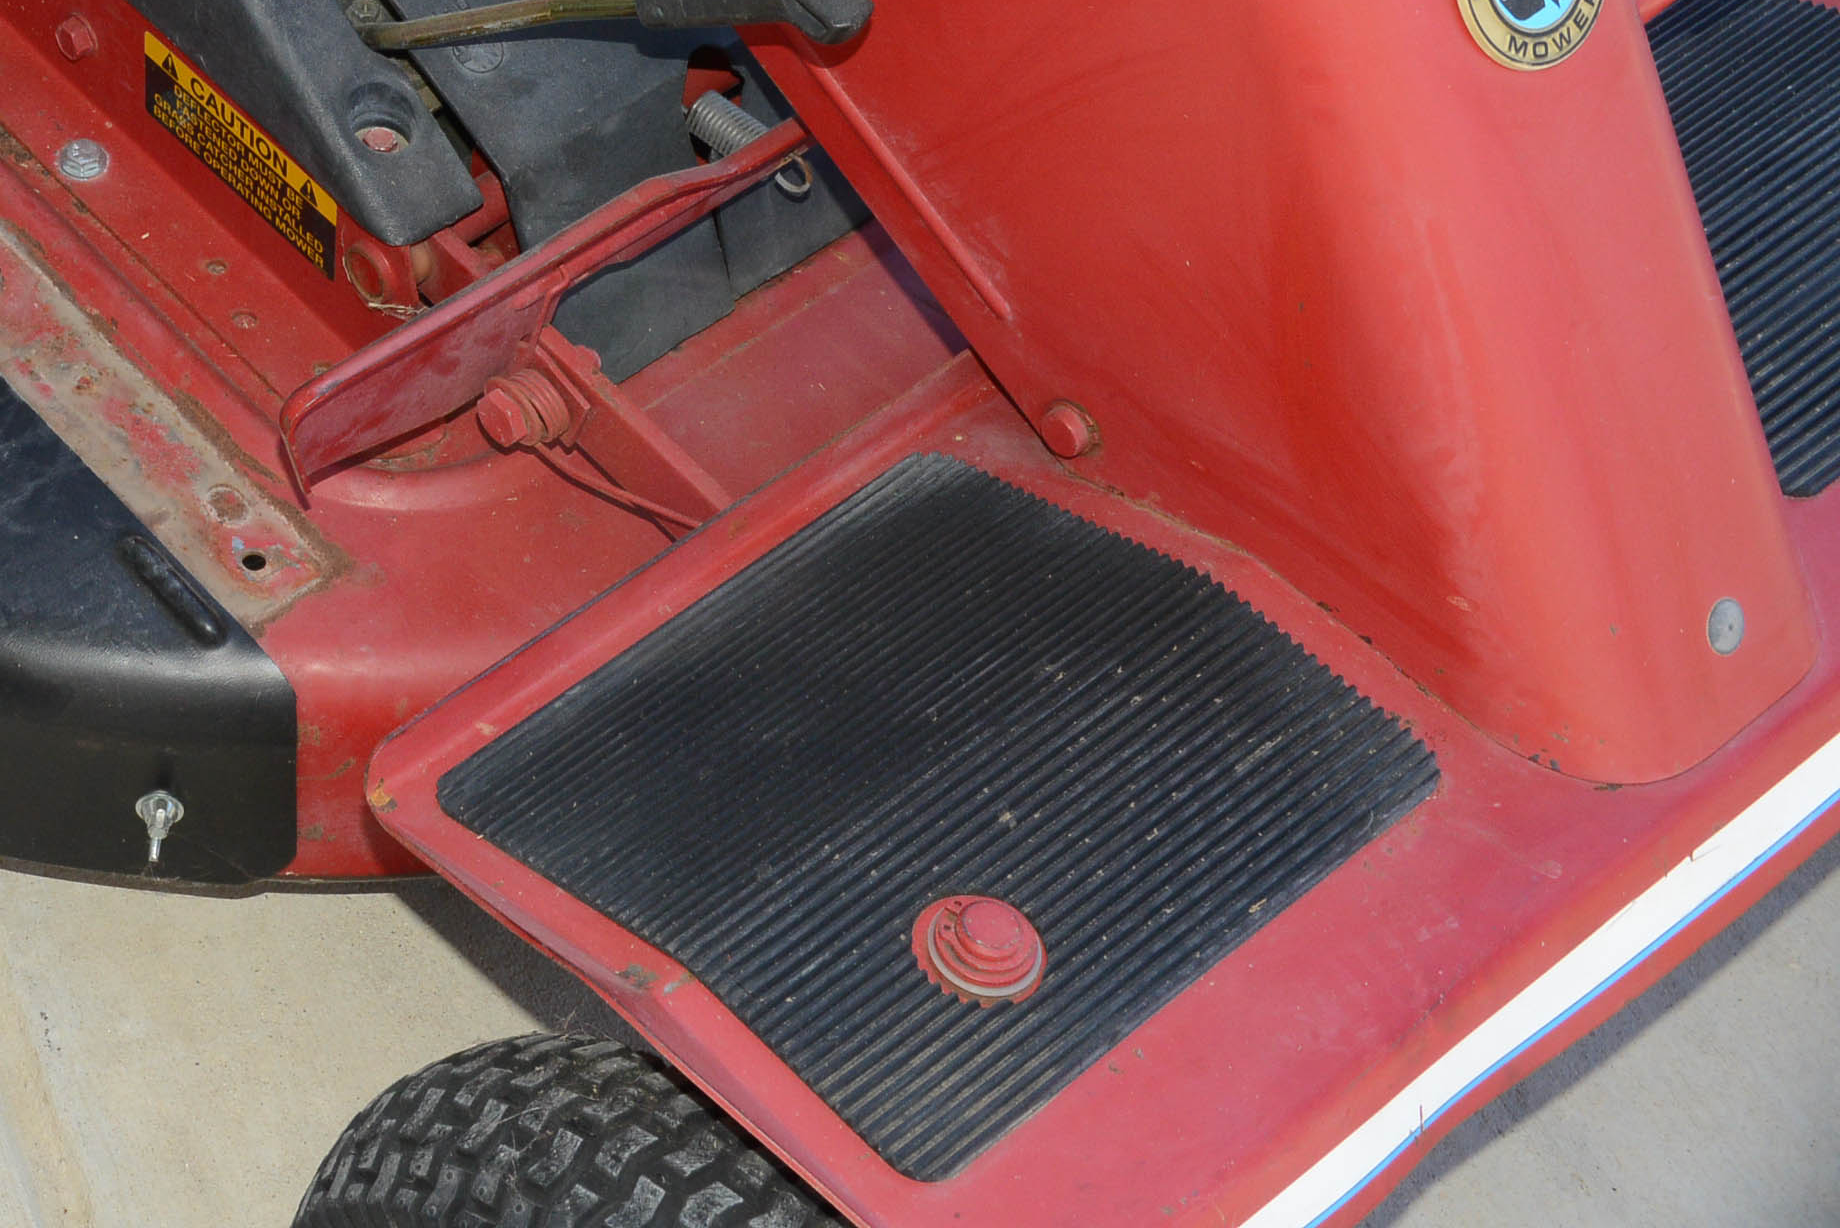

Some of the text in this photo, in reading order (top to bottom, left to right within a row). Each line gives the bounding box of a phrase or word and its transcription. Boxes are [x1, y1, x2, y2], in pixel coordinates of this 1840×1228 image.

[153, 102, 324, 269] BEFORE OPERATING MOWER
[154, 90, 323, 256] GRASS CATCHER INSTALLED
[174, 83, 303, 210] DEFLECTOR MUST BE
[176, 97, 301, 222] FASTENED DOWN OR
[189, 72, 287, 179] CAUTION
